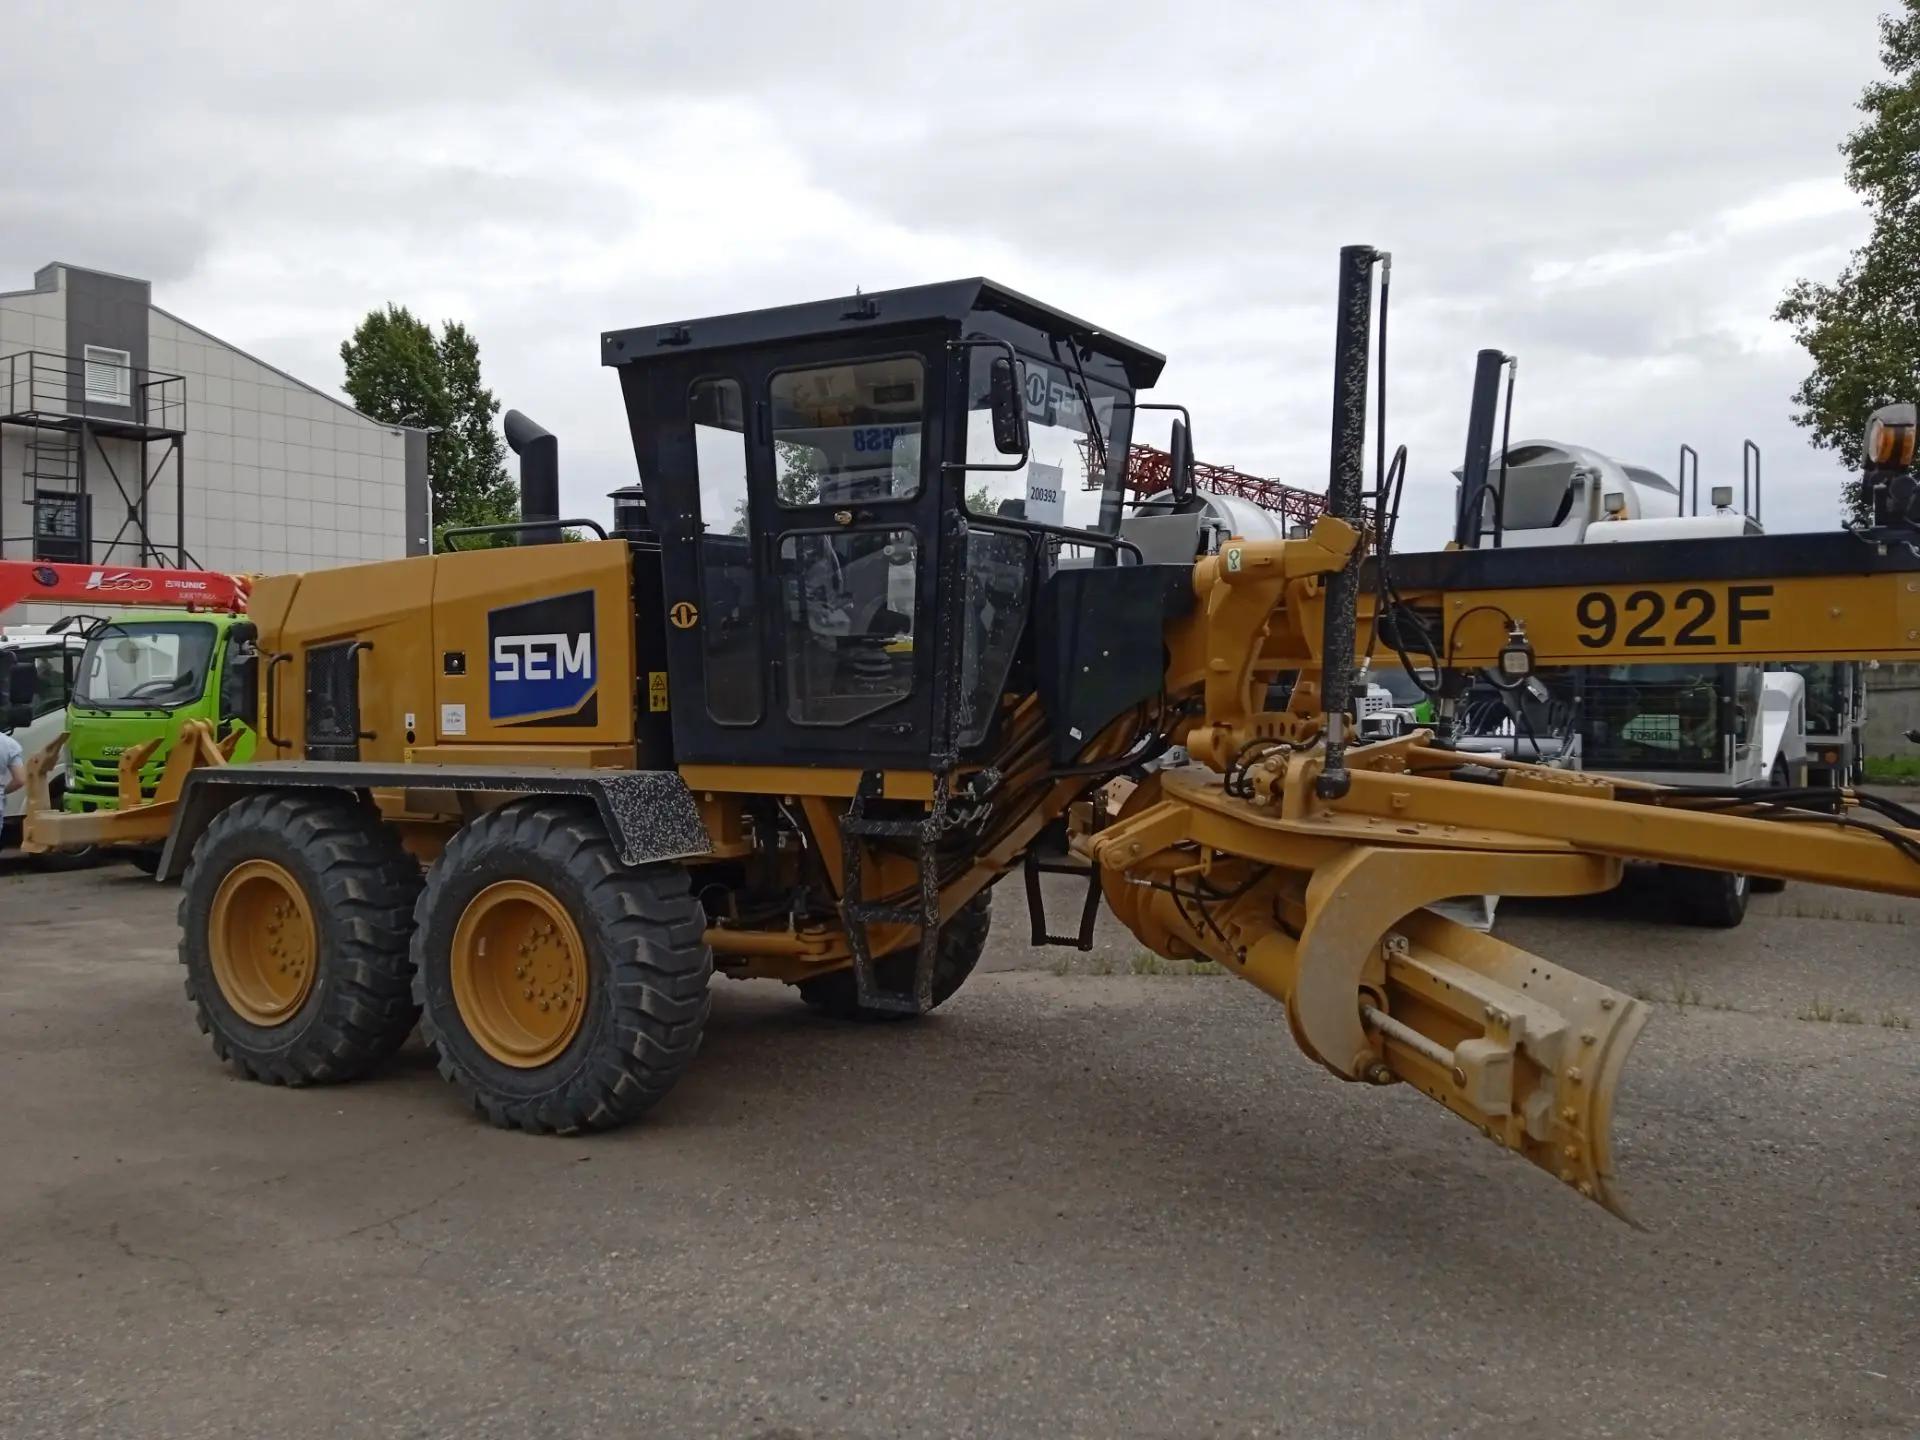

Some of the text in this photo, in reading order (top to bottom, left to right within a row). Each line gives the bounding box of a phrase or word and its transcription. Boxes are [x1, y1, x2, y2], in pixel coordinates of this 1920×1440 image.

[1030, 486, 1057, 503] 200392
[181, 580, 208, 590] UNIC
[1576, 585, 1774, 648] 922F
[494, 632, 592, 681] SEM
